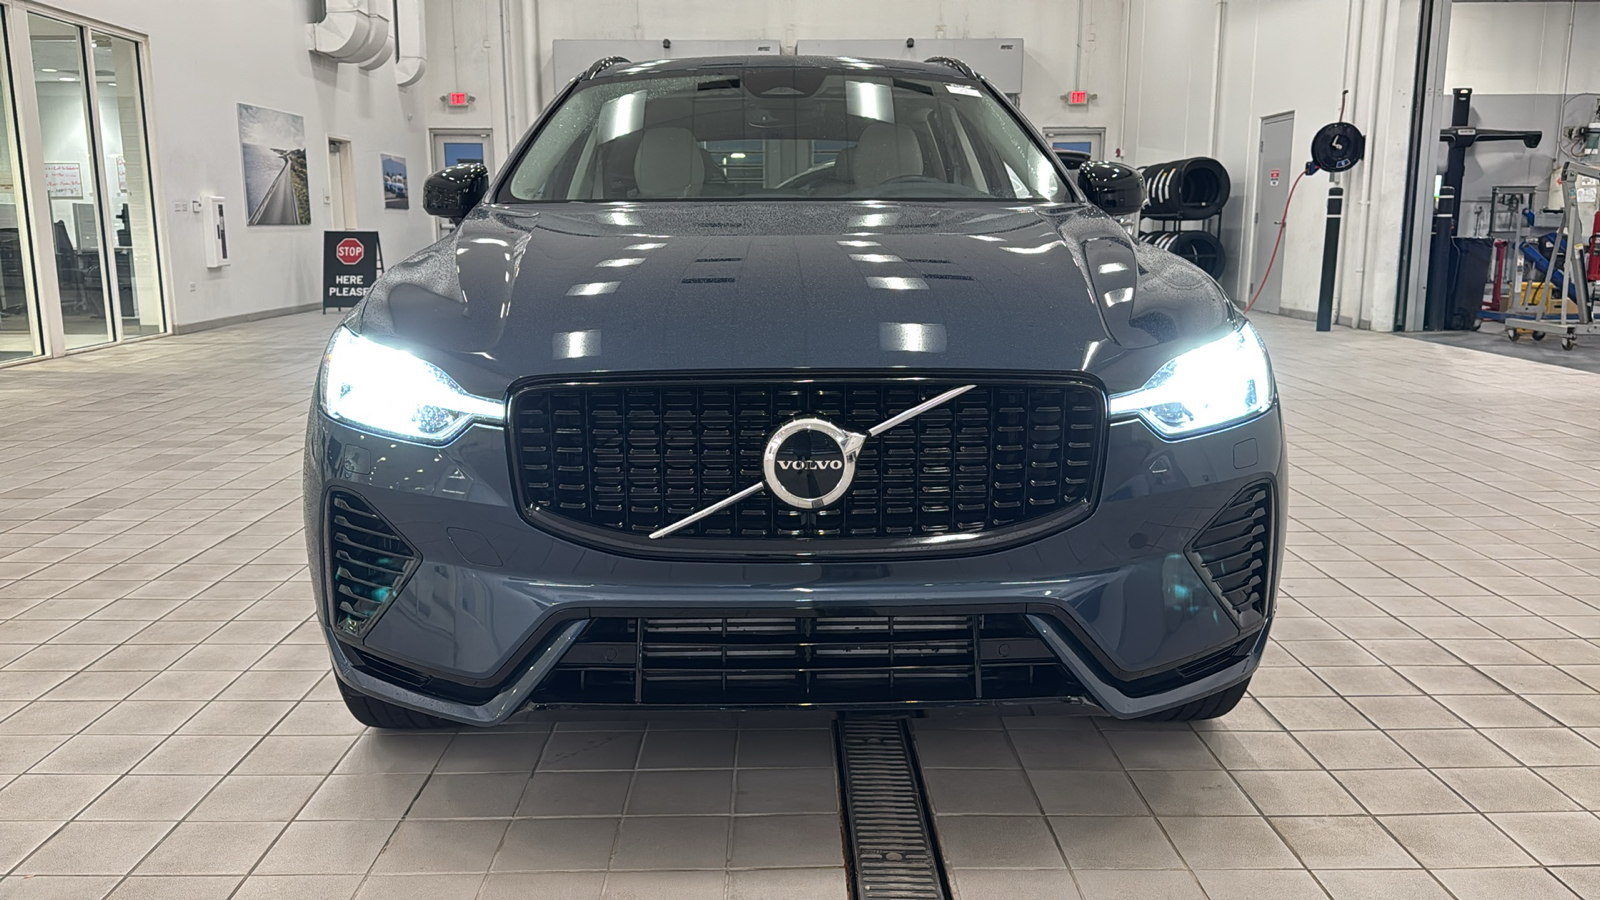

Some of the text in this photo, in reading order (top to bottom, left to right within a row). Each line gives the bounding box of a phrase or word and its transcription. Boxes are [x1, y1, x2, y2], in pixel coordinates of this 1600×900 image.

[338, 246, 362, 257] STOP
[335, 275, 364, 285] HERE
[777, 460, 843, 470] VOLVO
